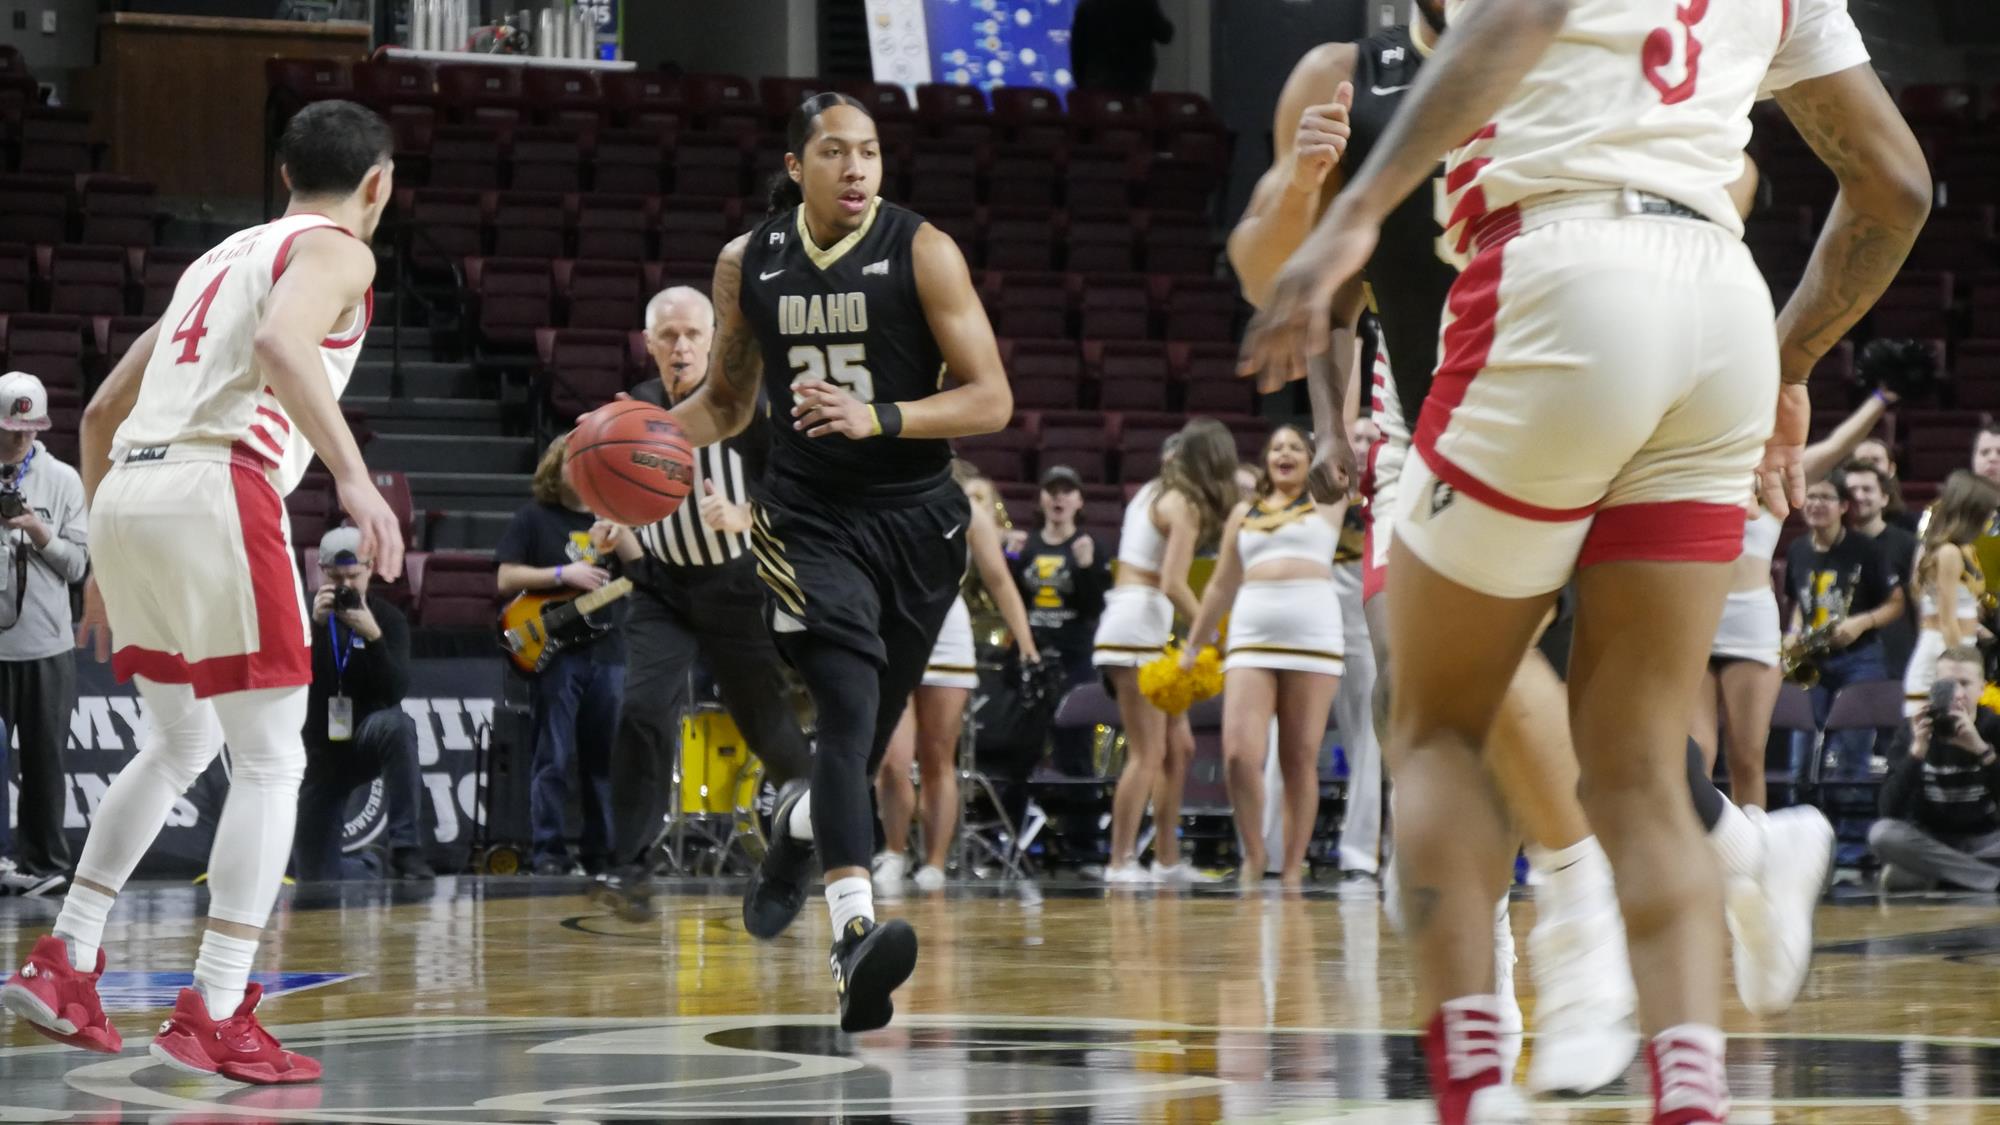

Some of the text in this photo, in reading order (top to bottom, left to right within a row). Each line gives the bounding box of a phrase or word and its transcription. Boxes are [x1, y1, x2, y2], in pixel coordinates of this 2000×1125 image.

[769, 232, 785, 245] PI
[171, 265, 231, 366] 4
[778, 291, 868, 335] IDAHO
[787, 343, 875, 405] 25
